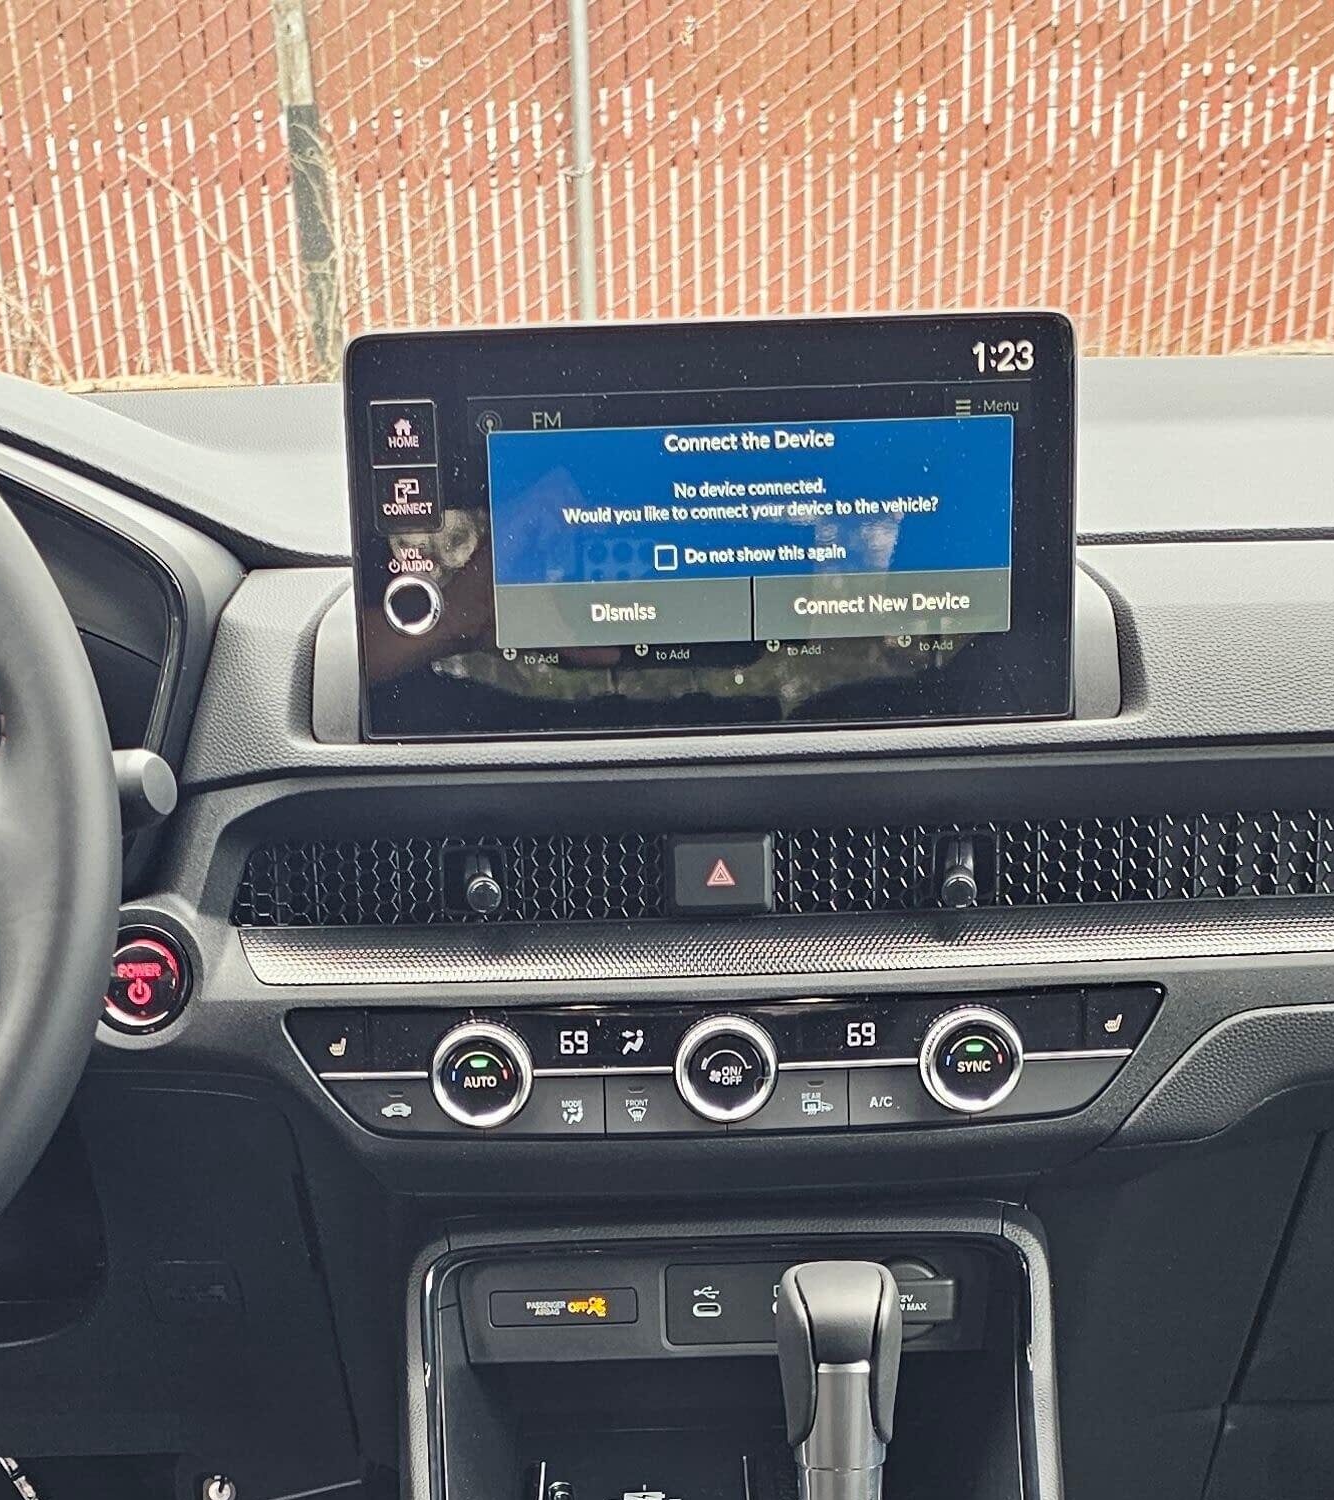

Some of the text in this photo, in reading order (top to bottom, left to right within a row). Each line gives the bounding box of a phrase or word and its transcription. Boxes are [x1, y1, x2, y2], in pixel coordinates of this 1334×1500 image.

[971, 339, 1035, 373] 1:23
[983, 399, 1019, 412] Menu
[532, 411, 562, 430] FM
[387, 436, 420, 448] HOME
[664, 428, 835, 453] Connect the Device
[673, 477, 827, 499] No device connected.
[382, 502, 433, 516] CONNECT
[562, 495, 940, 526] Would you like to connect your device to the vehicle?
[400, 548, 423, 559] VOL
[684, 543, 847, 564] Do not show this again
[401, 559, 434, 572] AUDIO
[793, 591, 971, 615] Connect New Device
[590, 602, 657, 622] Dismiss
[787, 645, 821, 656] to Add
[919, 640, 954, 651] to Add
[524, 653, 559, 665] to Add
[656, 649, 690, 661] to Add
[117, 962, 162, 977] POWER
[846, 1022, 876, 1047] 69
[560, 1030, 589, 1055] 69
[721, 1066, 742, 1077] ON/
[957, 1060, 992, 1073] SYNC
[463, 1075, 498, 1089] AUTO
[721, 1075, 743, 1086] OFF
[625, 1098, 649, 1108] FRONT
[801, 1092, 822, 1101] REAR
[869, 1095, 894, 1109] A/C
[561, 1099, 583, 1109] MODE
[898, 1294, 914, 1303] 2V
[567, 1301, 589, 1313] OFF
[906, 1302, 927, 1311] MAX
